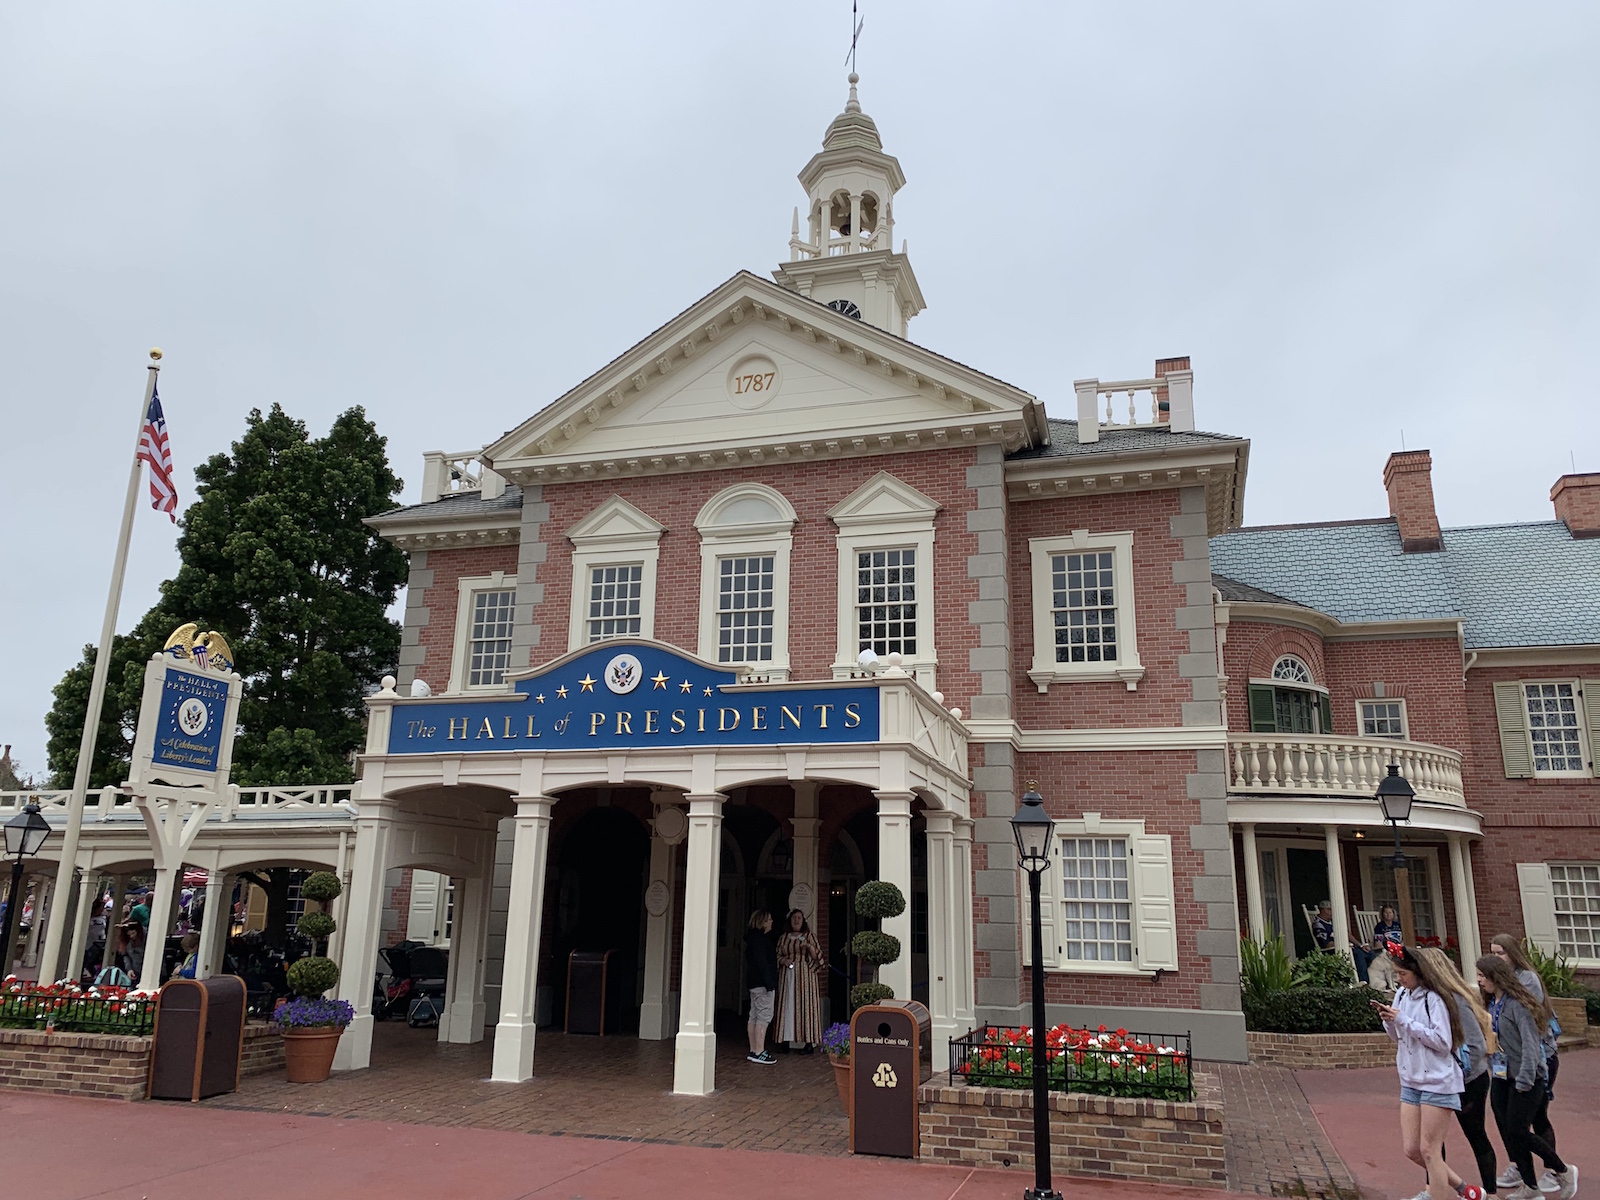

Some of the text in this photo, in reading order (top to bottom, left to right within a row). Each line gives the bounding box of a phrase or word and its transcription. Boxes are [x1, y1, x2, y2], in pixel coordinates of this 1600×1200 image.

[735, 371, 775, 394] 1787
[167, 681, 225, 701] PRESIDENTS
[188, 677, 211, 689] HALL
[407, 702, 862, 740] The HALL of PRESIDENTS
[174, 739, 207, 753] Celebration
[208, 746, 216, 755] of
[161, 749, 211, 766] Liberty's Leaders
[857, 1036, 873, 1044] Bottles
[897, 1039, 909, 1047] Only
